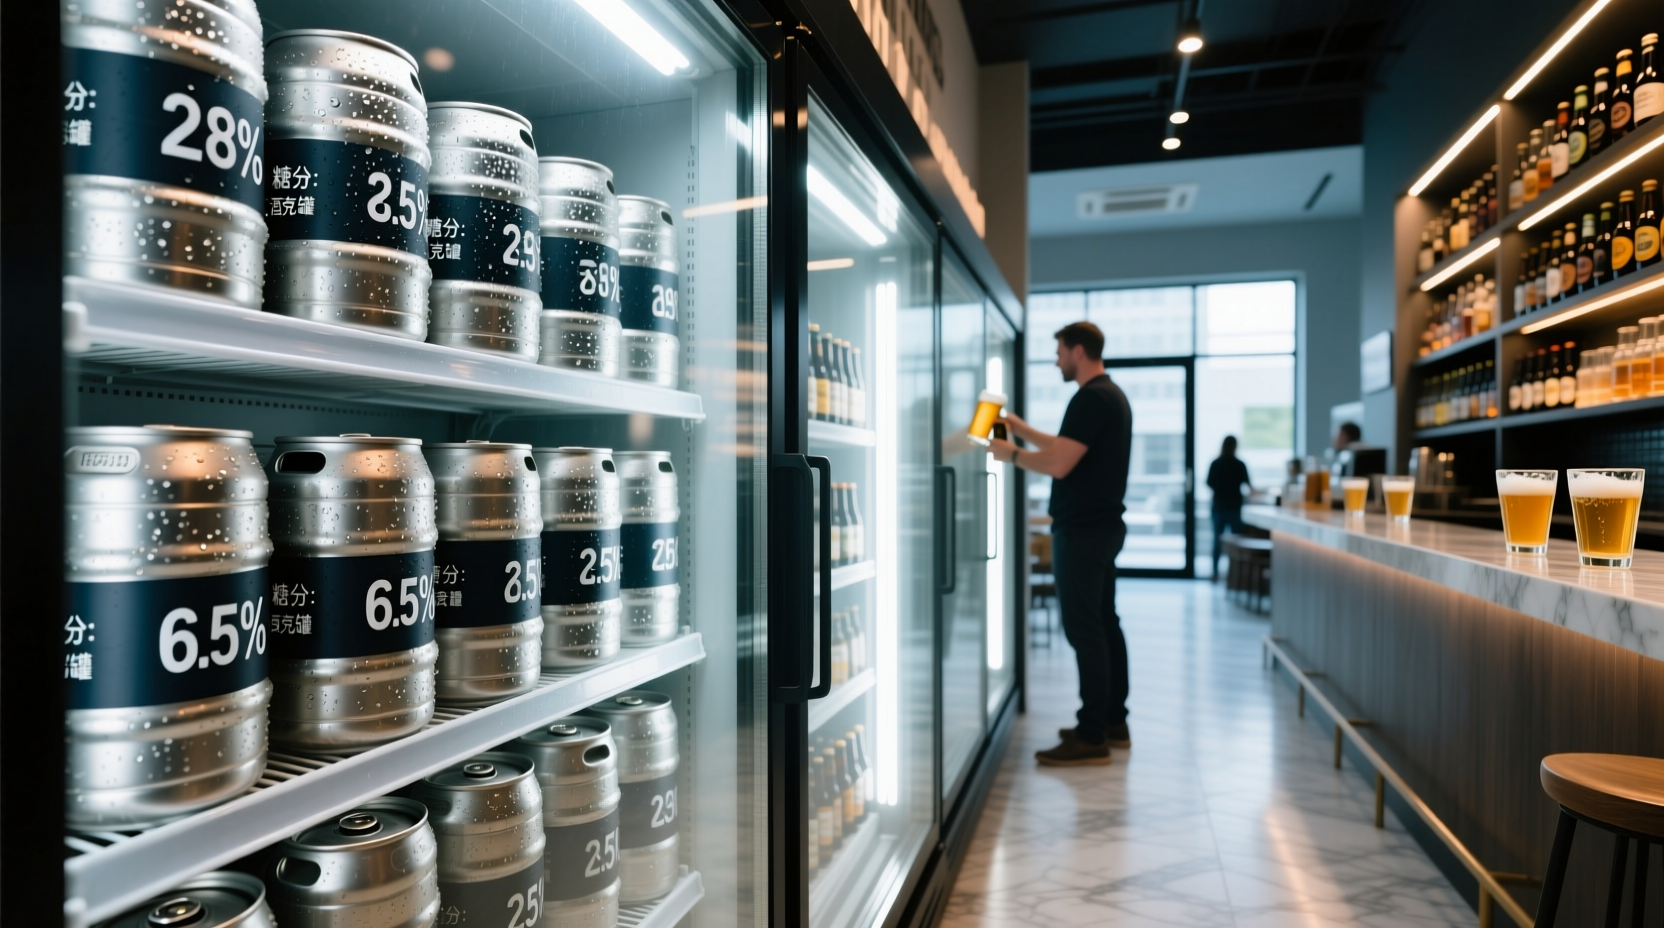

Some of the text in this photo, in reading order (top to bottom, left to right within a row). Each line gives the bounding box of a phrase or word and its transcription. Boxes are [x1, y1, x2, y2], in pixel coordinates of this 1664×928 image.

[161, 92, 264, 186] 28%
[272, 165, 318, 189] 糖分:
[272, 583, 315, 606] 糖分:
[366, 575, 435, 631] 6.5%
[159, 596, 267, 673] 6.5%
